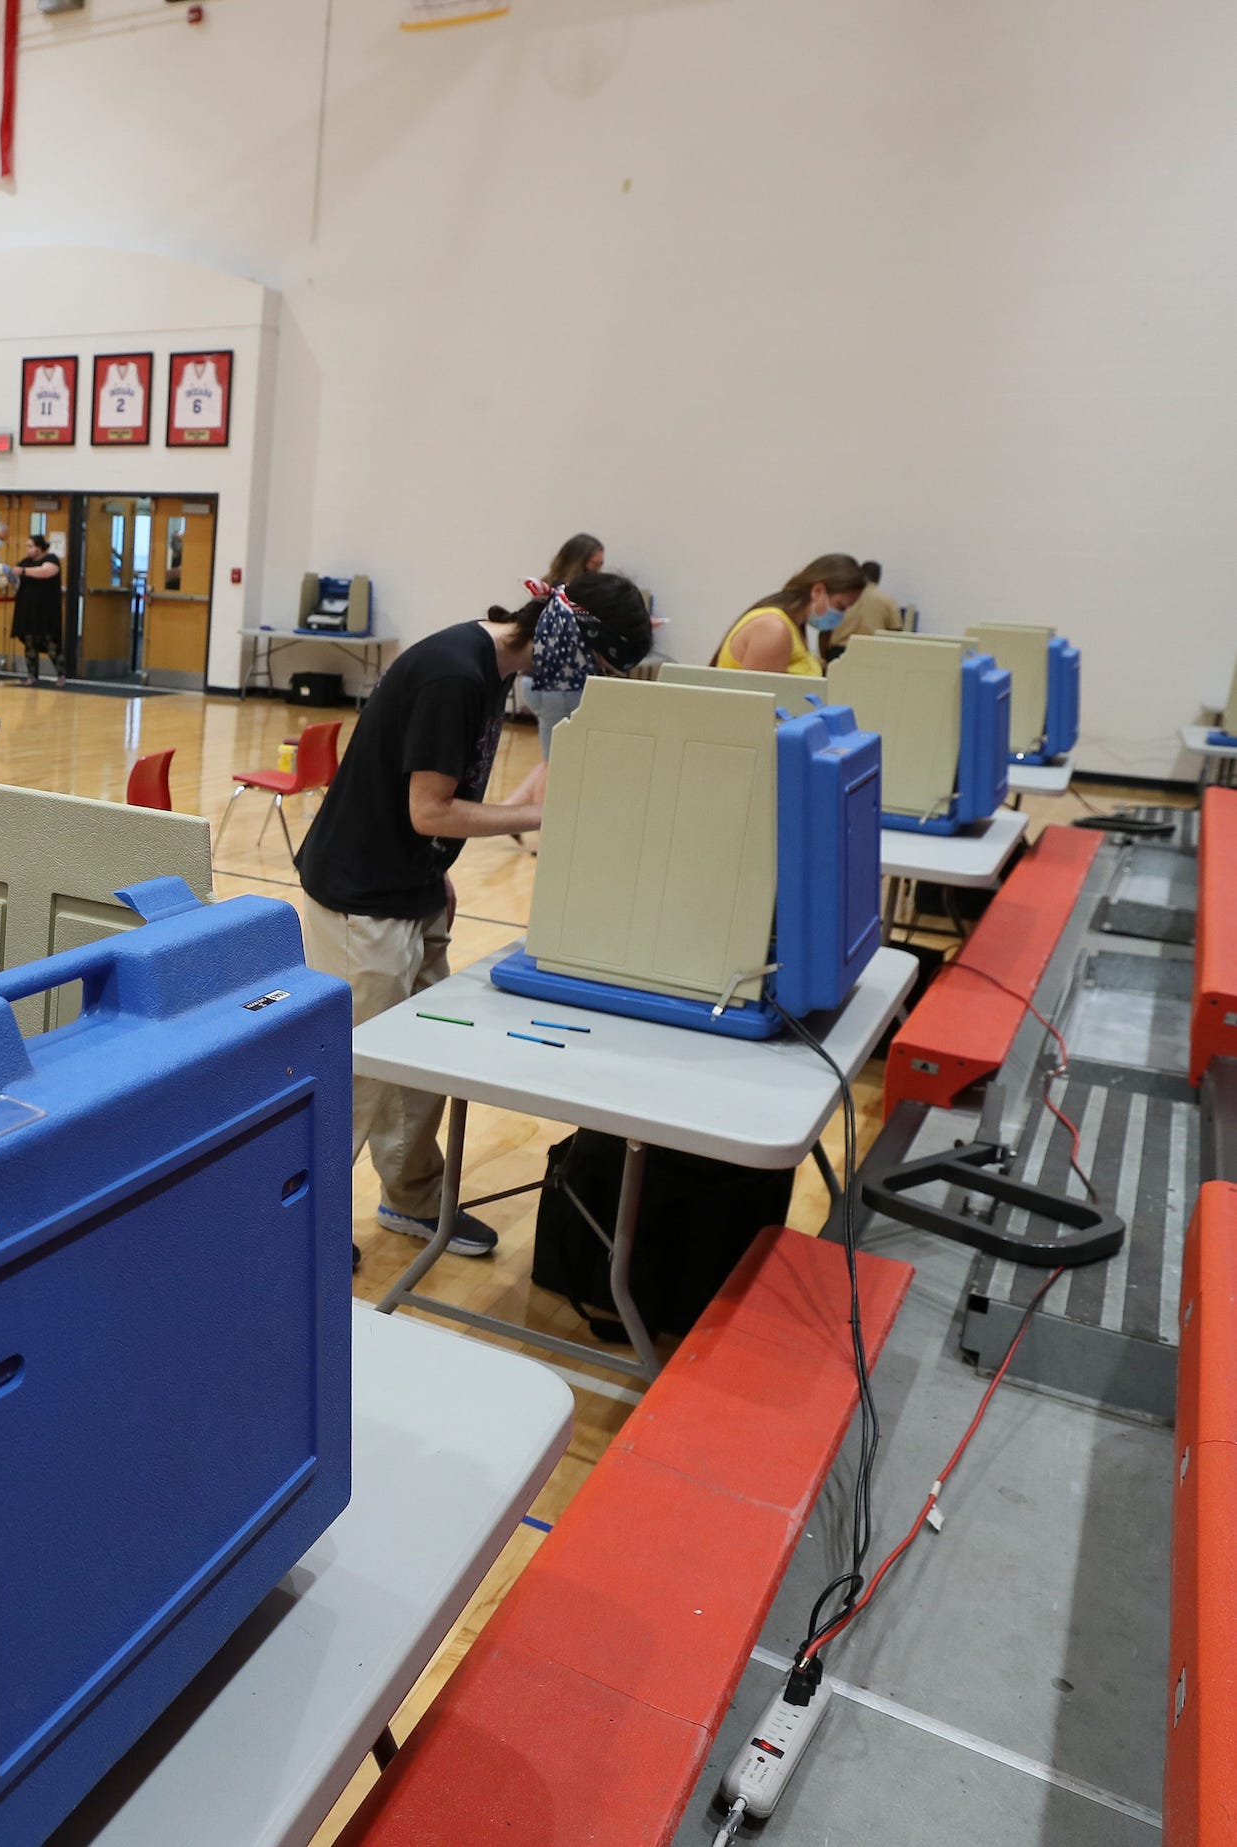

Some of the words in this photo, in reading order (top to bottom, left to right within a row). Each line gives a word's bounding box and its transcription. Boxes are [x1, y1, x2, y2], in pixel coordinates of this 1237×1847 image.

[41, 401, 52, 416] 11
[116, 398, 125, 413] 2
[193, 399, 202, 414] 6
